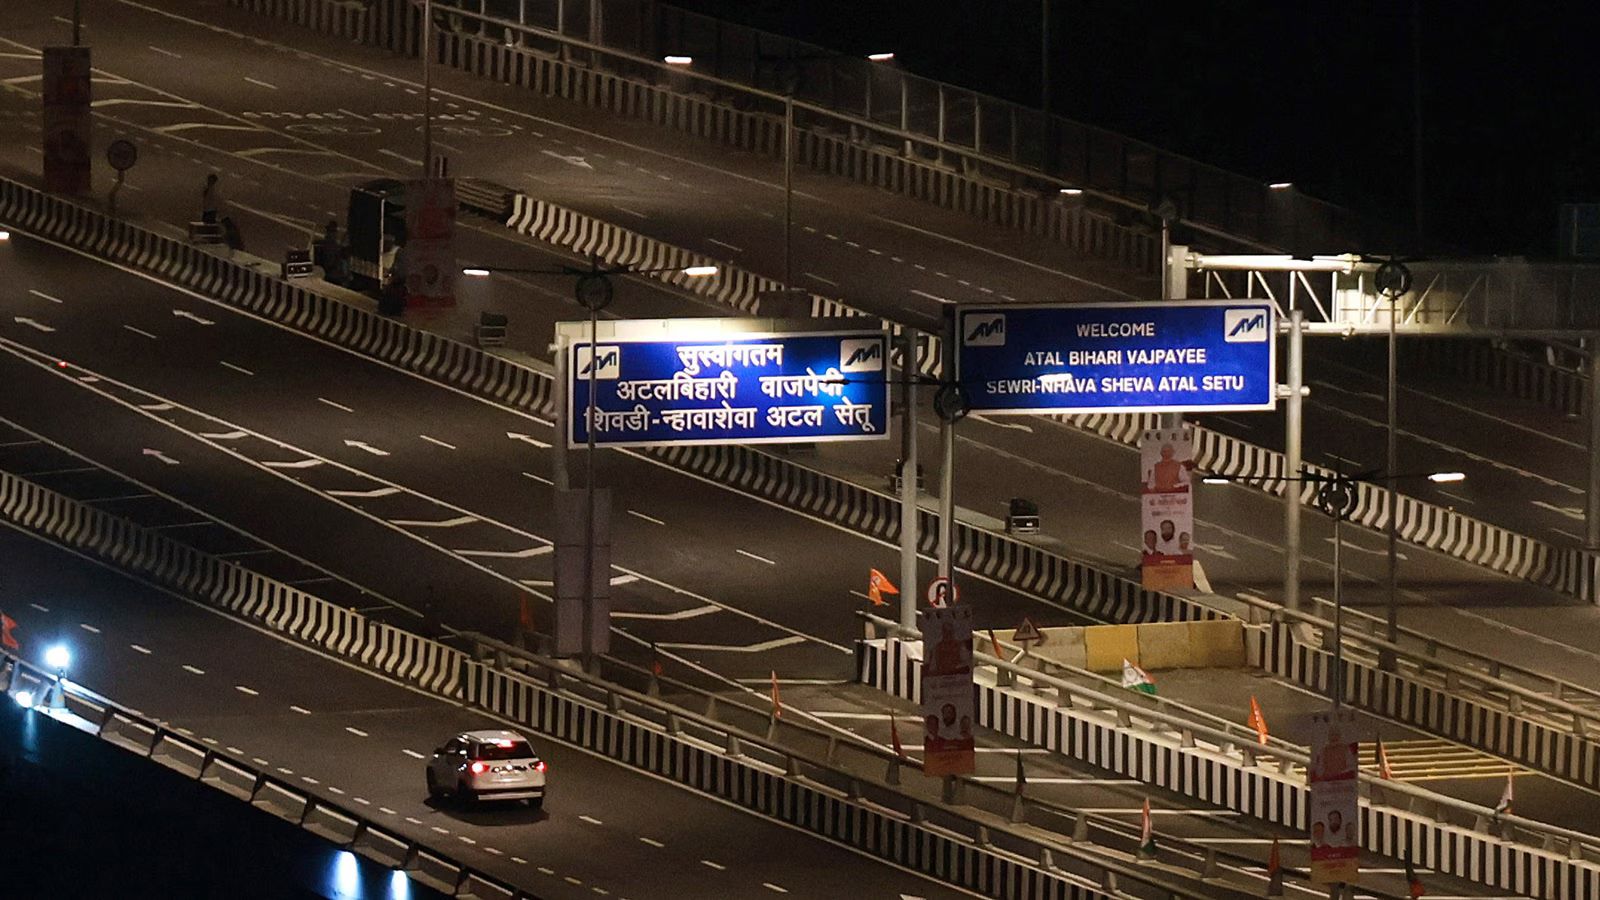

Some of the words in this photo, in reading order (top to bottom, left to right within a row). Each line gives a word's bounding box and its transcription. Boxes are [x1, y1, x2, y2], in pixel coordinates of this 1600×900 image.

[1076, 322, 1155, 338] WELCOME
[676, 344, 784, 375] सुस्वागतम
[1024, 350, 1064, 366] ATAL
[1069, 349, 1121, 365] BIHARI
[1127, 348, 1207, 364] VAJPAYEE
[617, 370, 738, 401] अटलबिहारी
[758, 366, 845, 398] वाजपेयी
[1101, 377, 1154, 393] SHEVA
[1158, 375, 1198, 391] ATAL
[1202, 375, 1244, 391] SETU
[766, 404, 825, 428] अटल
[833, 396, 876, 432] सेतू
